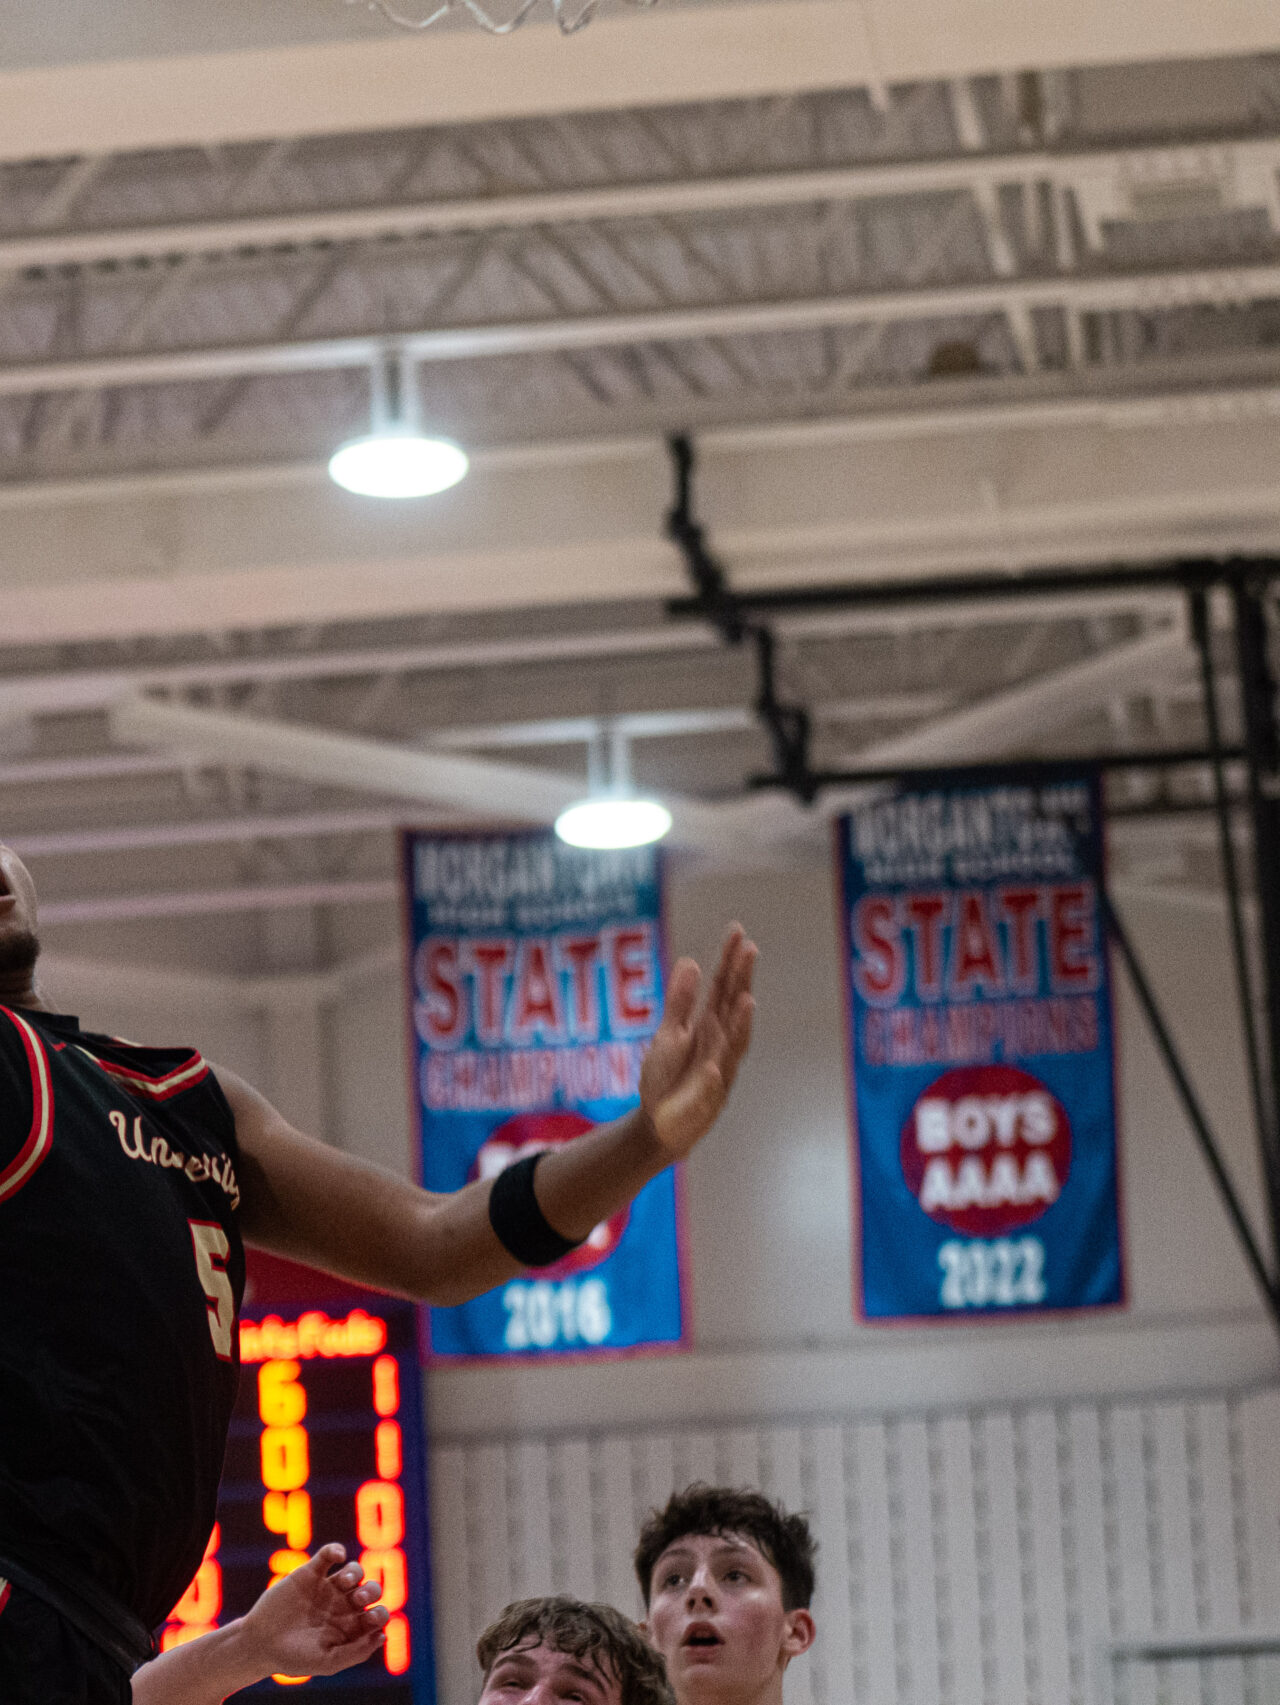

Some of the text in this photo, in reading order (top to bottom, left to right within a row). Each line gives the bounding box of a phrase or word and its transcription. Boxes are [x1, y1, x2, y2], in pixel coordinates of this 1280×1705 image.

[852, 882, 1102, 1010] STATE
[416, 922, 658, 1051] STATE
[864, 996, 1098, 1067] CHAMPIONS
[425, 1044, 640, 1112] CHAMPION
[916, 1090, 1057, 1153] BOYS
[920, 1152, 1059, 1213] AAAA
[187, 1218, 235, 1363] 5
[938, 1235, 1046, 1307] 2022
